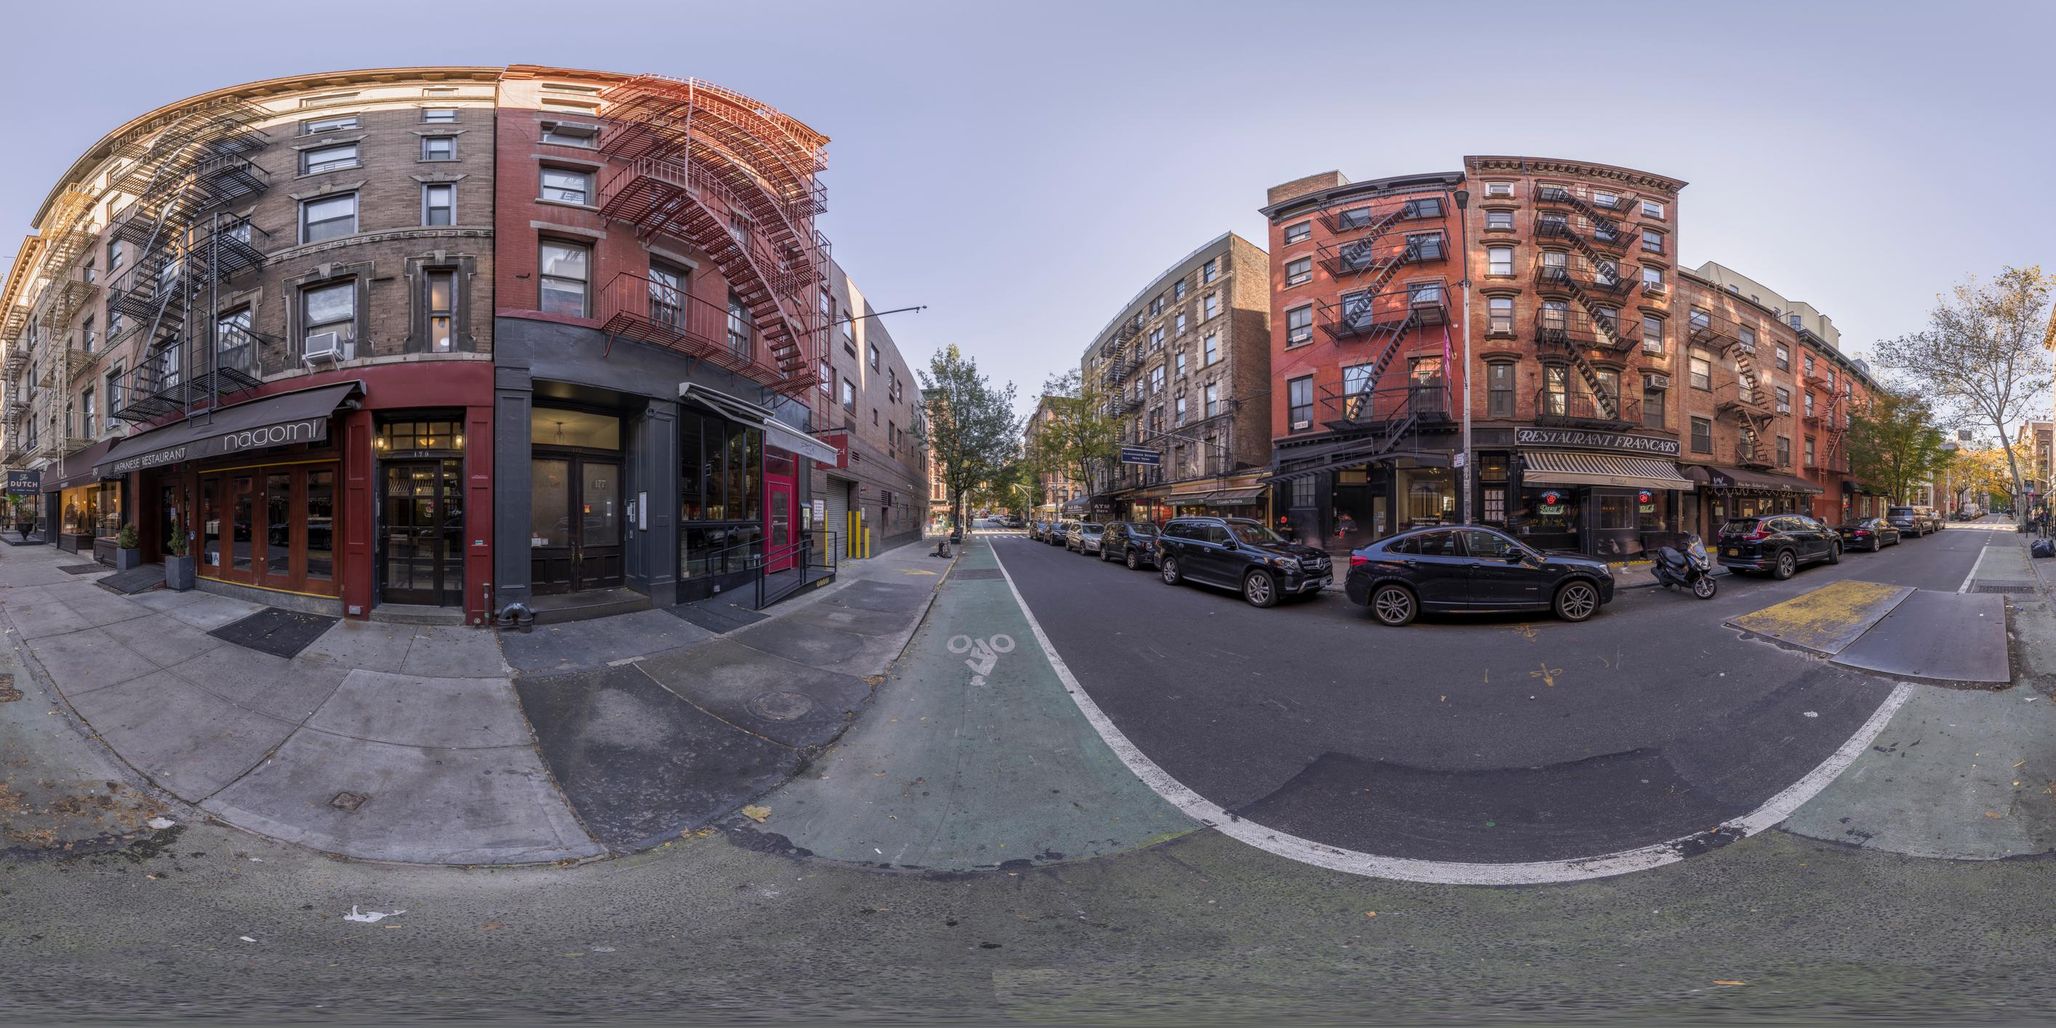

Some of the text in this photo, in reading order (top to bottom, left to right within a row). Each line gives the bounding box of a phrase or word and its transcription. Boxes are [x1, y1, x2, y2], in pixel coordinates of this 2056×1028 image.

[224, 420, 316, 450] nagomi
[1518, 430, 1613, 446] RESTAURANT
[114, 448, 186, 472] JAPANESE RESTAURANT
[10, 480, 38, 488] DUTCH
